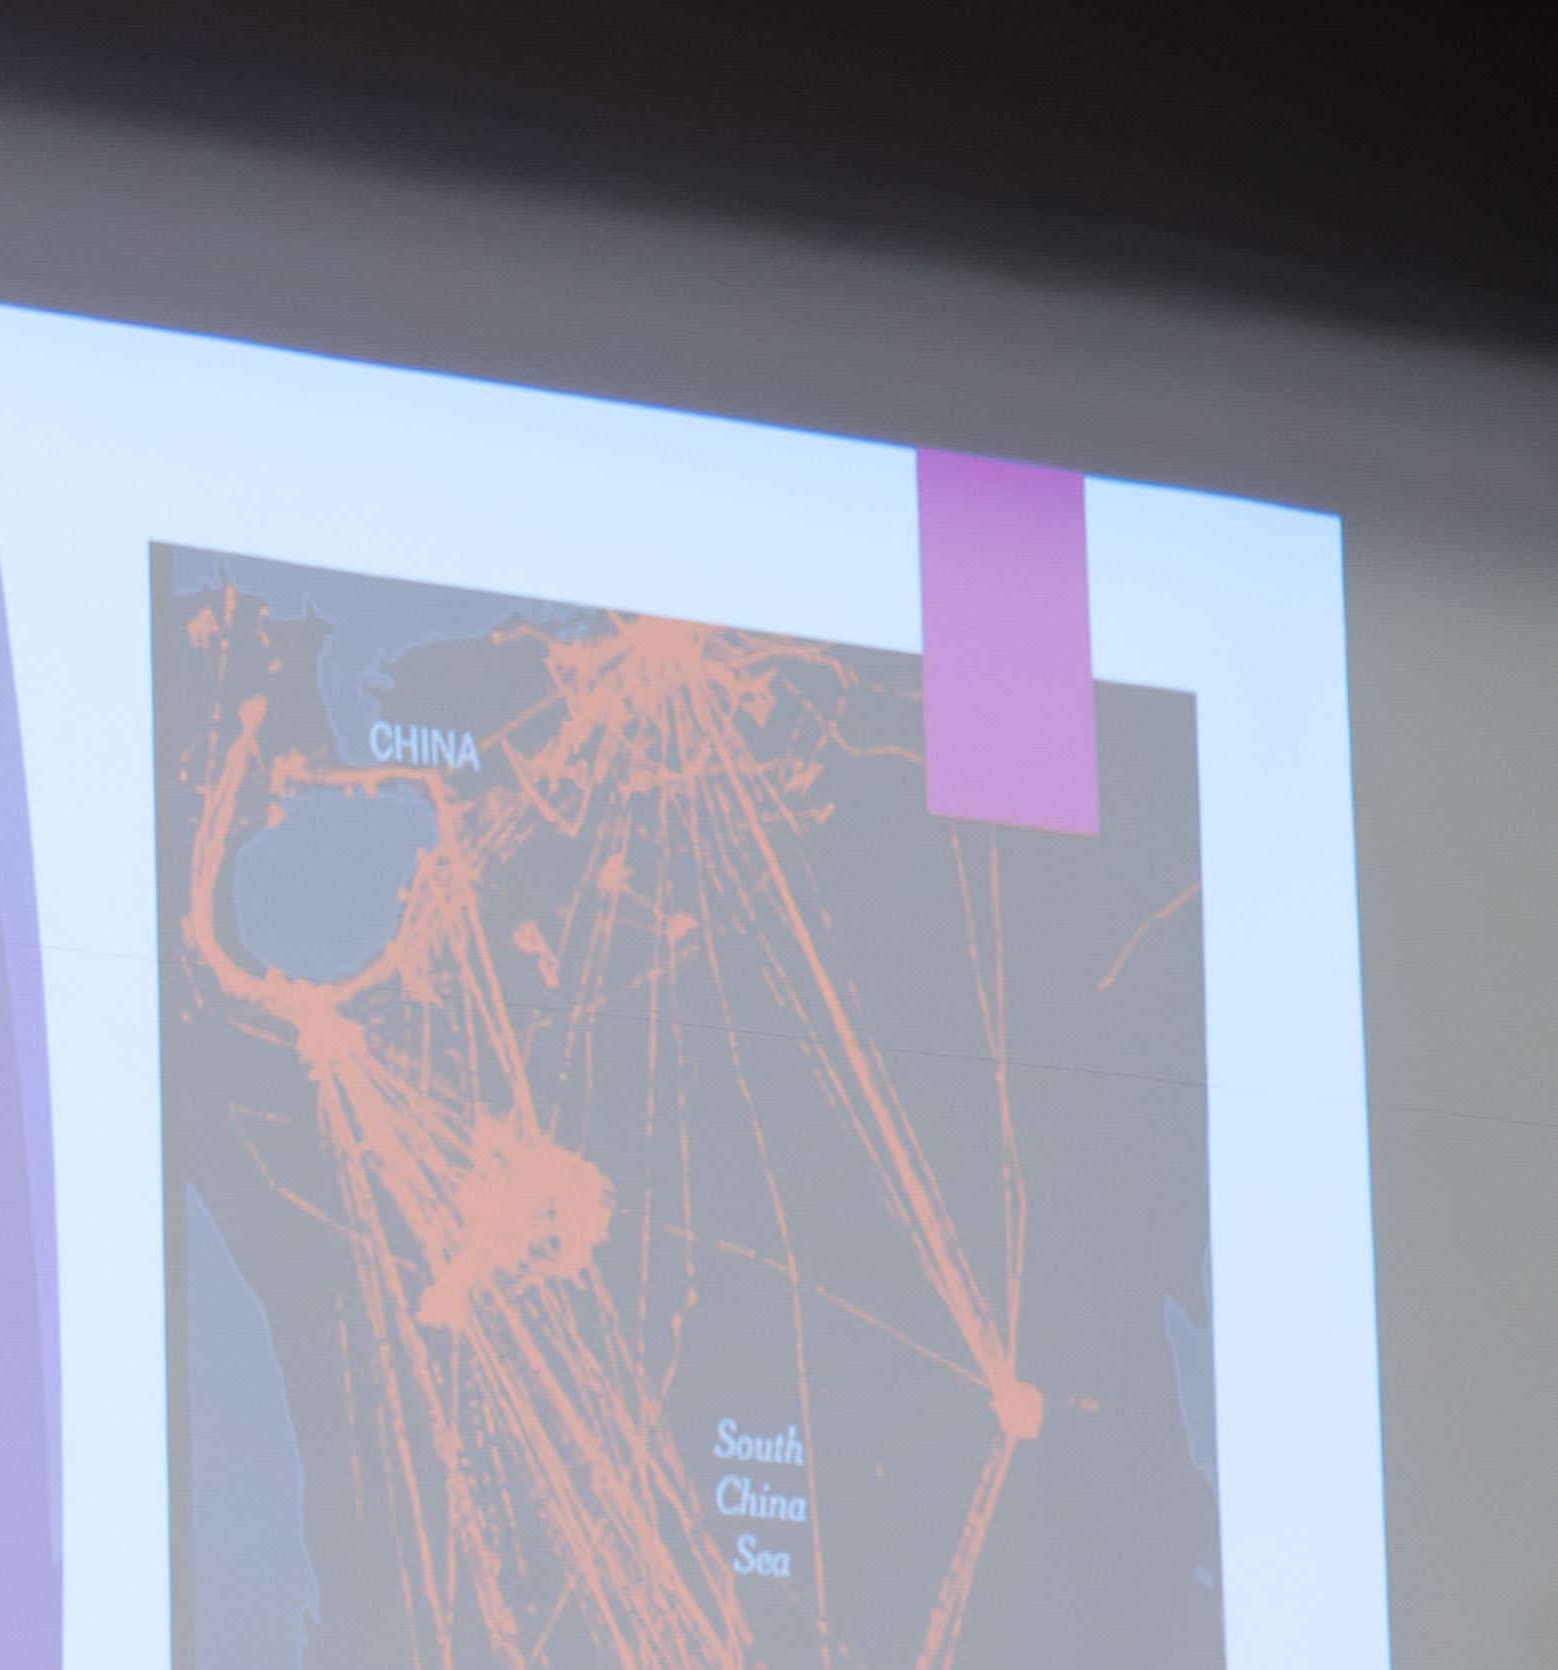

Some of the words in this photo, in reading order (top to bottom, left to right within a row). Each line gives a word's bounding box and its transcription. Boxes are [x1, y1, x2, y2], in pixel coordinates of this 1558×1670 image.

[369, 719, 481, 772] CHINA
[713, 1417, 805, 1465] South
[715, 1473, 807, 1522] China
[733, 1532, 791, 1578] Sea
